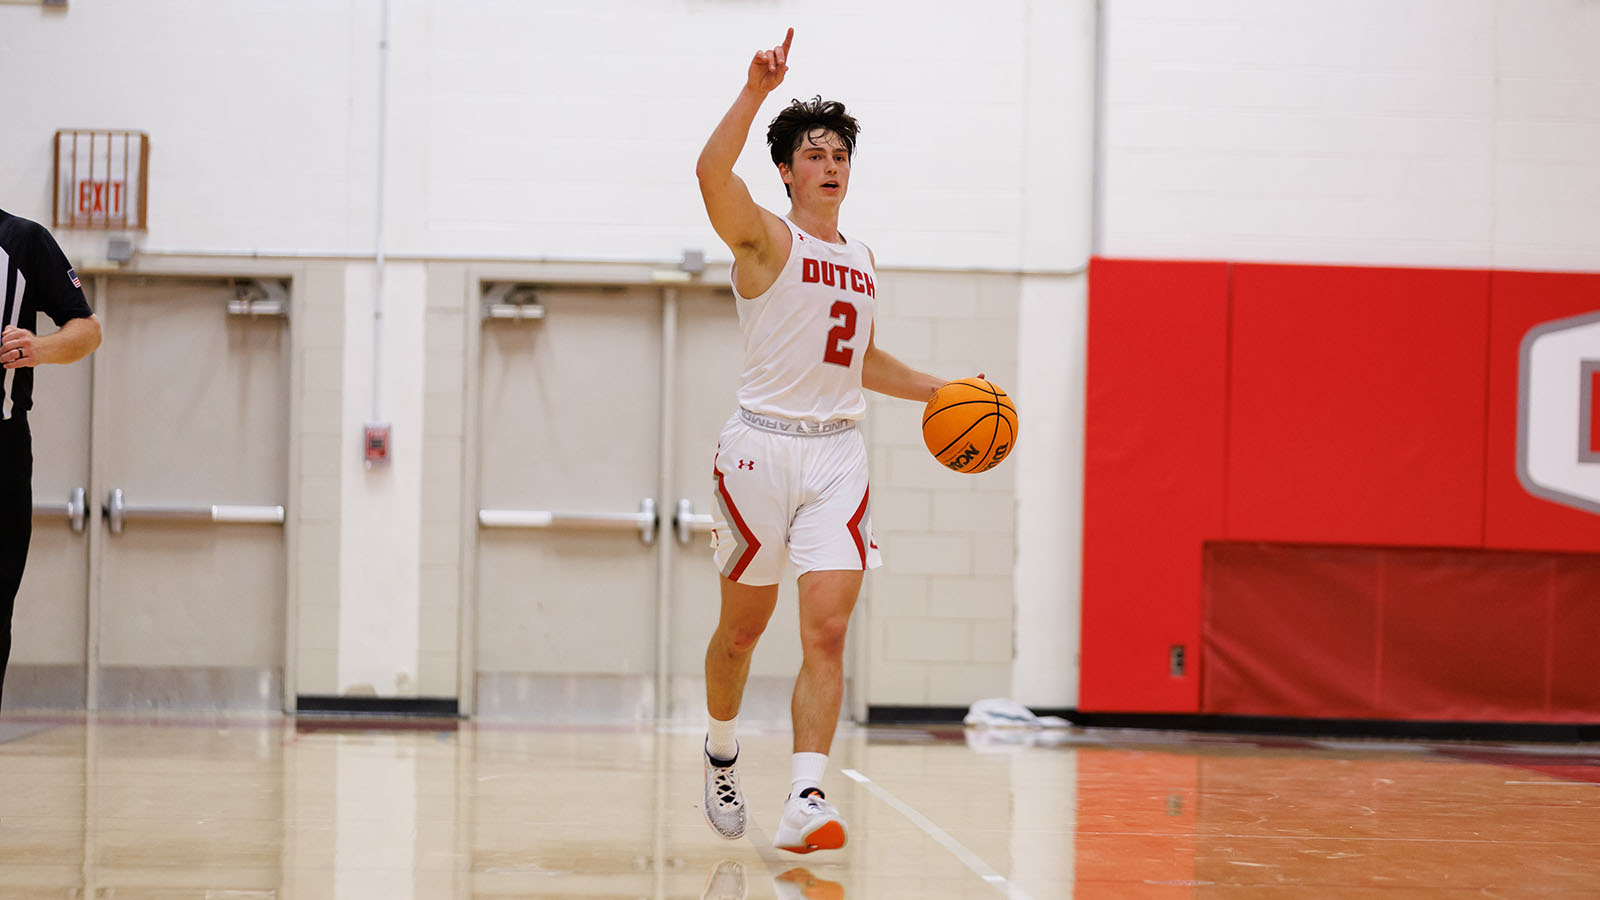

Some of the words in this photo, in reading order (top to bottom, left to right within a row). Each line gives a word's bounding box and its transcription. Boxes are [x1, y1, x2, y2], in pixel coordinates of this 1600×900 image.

[79, 180, 121, 213] EXIT
[802, 257, 876, 300] DUTCH
[823, 299, 858, 368] 2
